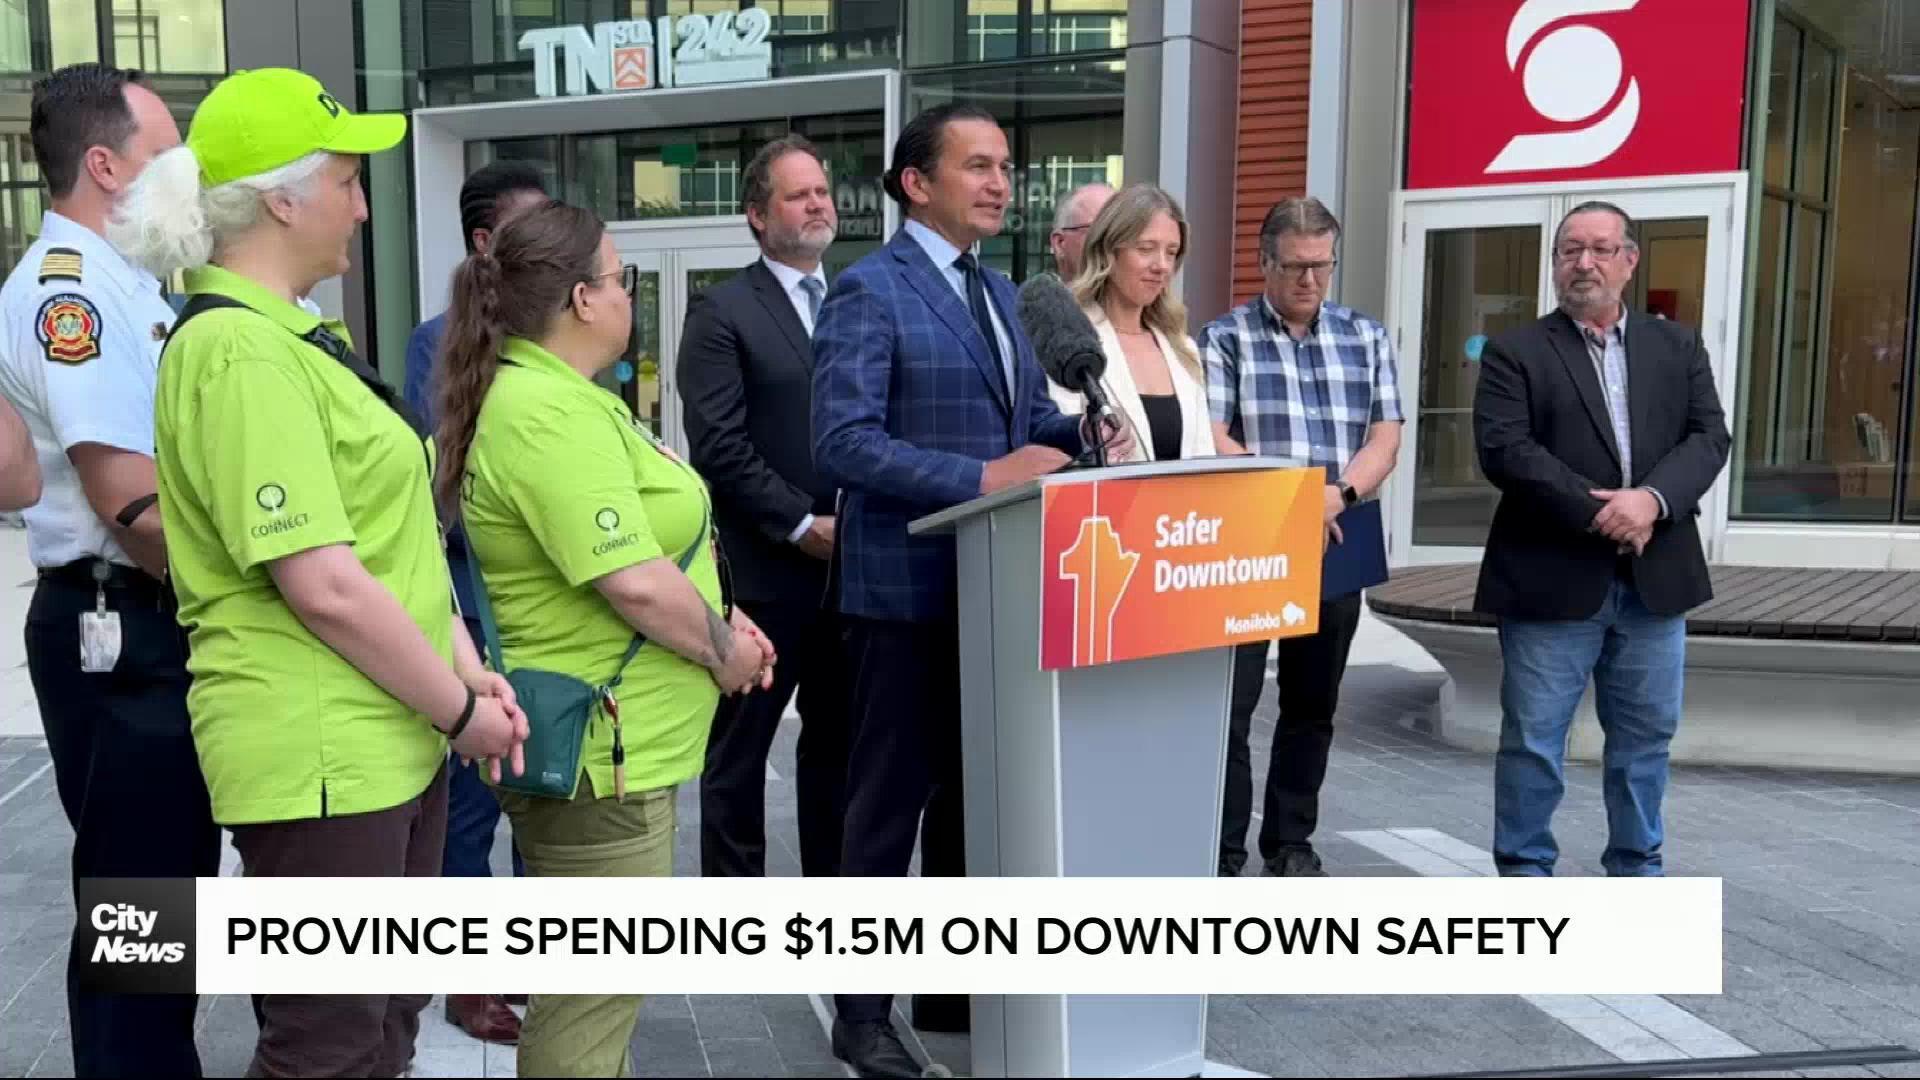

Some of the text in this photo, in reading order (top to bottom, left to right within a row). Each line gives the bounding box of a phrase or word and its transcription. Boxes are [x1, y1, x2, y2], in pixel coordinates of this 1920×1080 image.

[518, 22, 613, 97] TN
[676, 7, 772, 60] 242
[251, 513, 309, 539] CONNECT
[1155, 511, 1223, 549] Safer
[1154, 553, 1289, 593] Downtown
[1224, 610, 1281, 636] Manitoba
